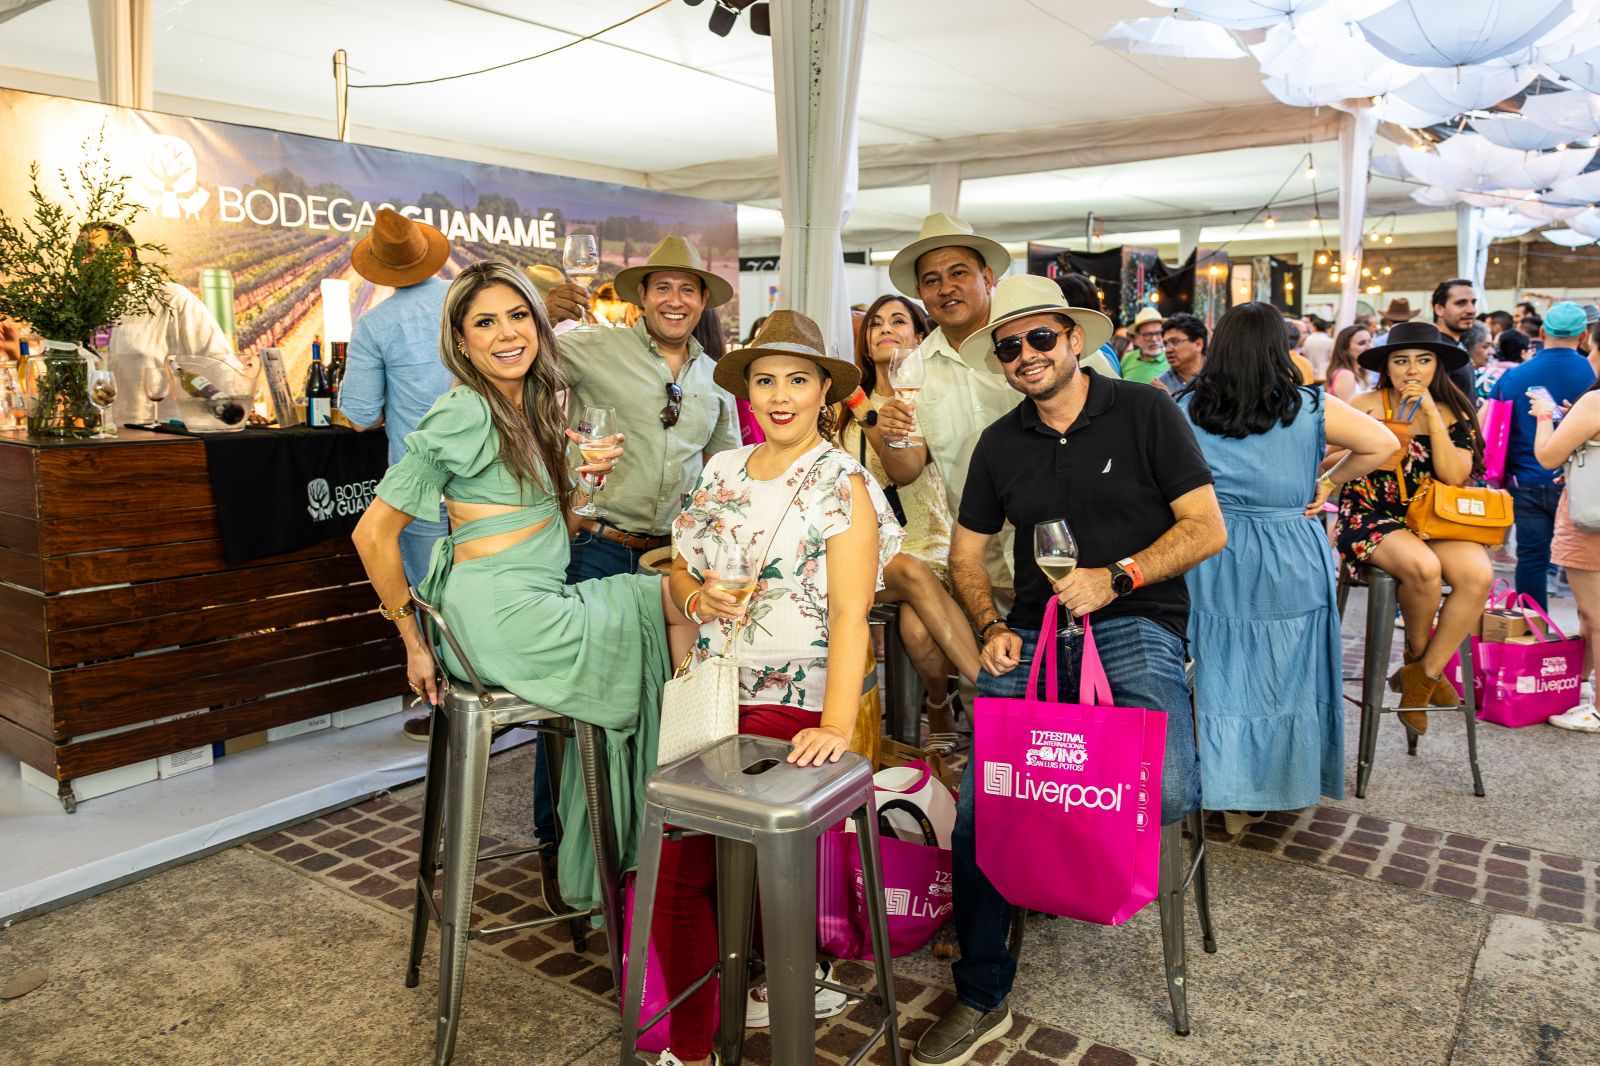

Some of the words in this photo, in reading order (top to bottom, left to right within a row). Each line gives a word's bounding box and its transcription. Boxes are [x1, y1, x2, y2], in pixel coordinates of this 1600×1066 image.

[218, 186, 396, 232] BODEGA
[335, 479, 382, 501] BODEG
[1536, 674, 1579, 694] Liverpool
[1043, 740, 1085, 750] INTERNACIONAL
[1045, 731, 1087, 744] FESTIVAL
[1032, 759, 1044, 767] SAN
[1044, 761, 1058, 769] LUIS
[1059, 762, 1084, 771] POTOSÍ
[1015, 771, 1123, 813] Liverpool
